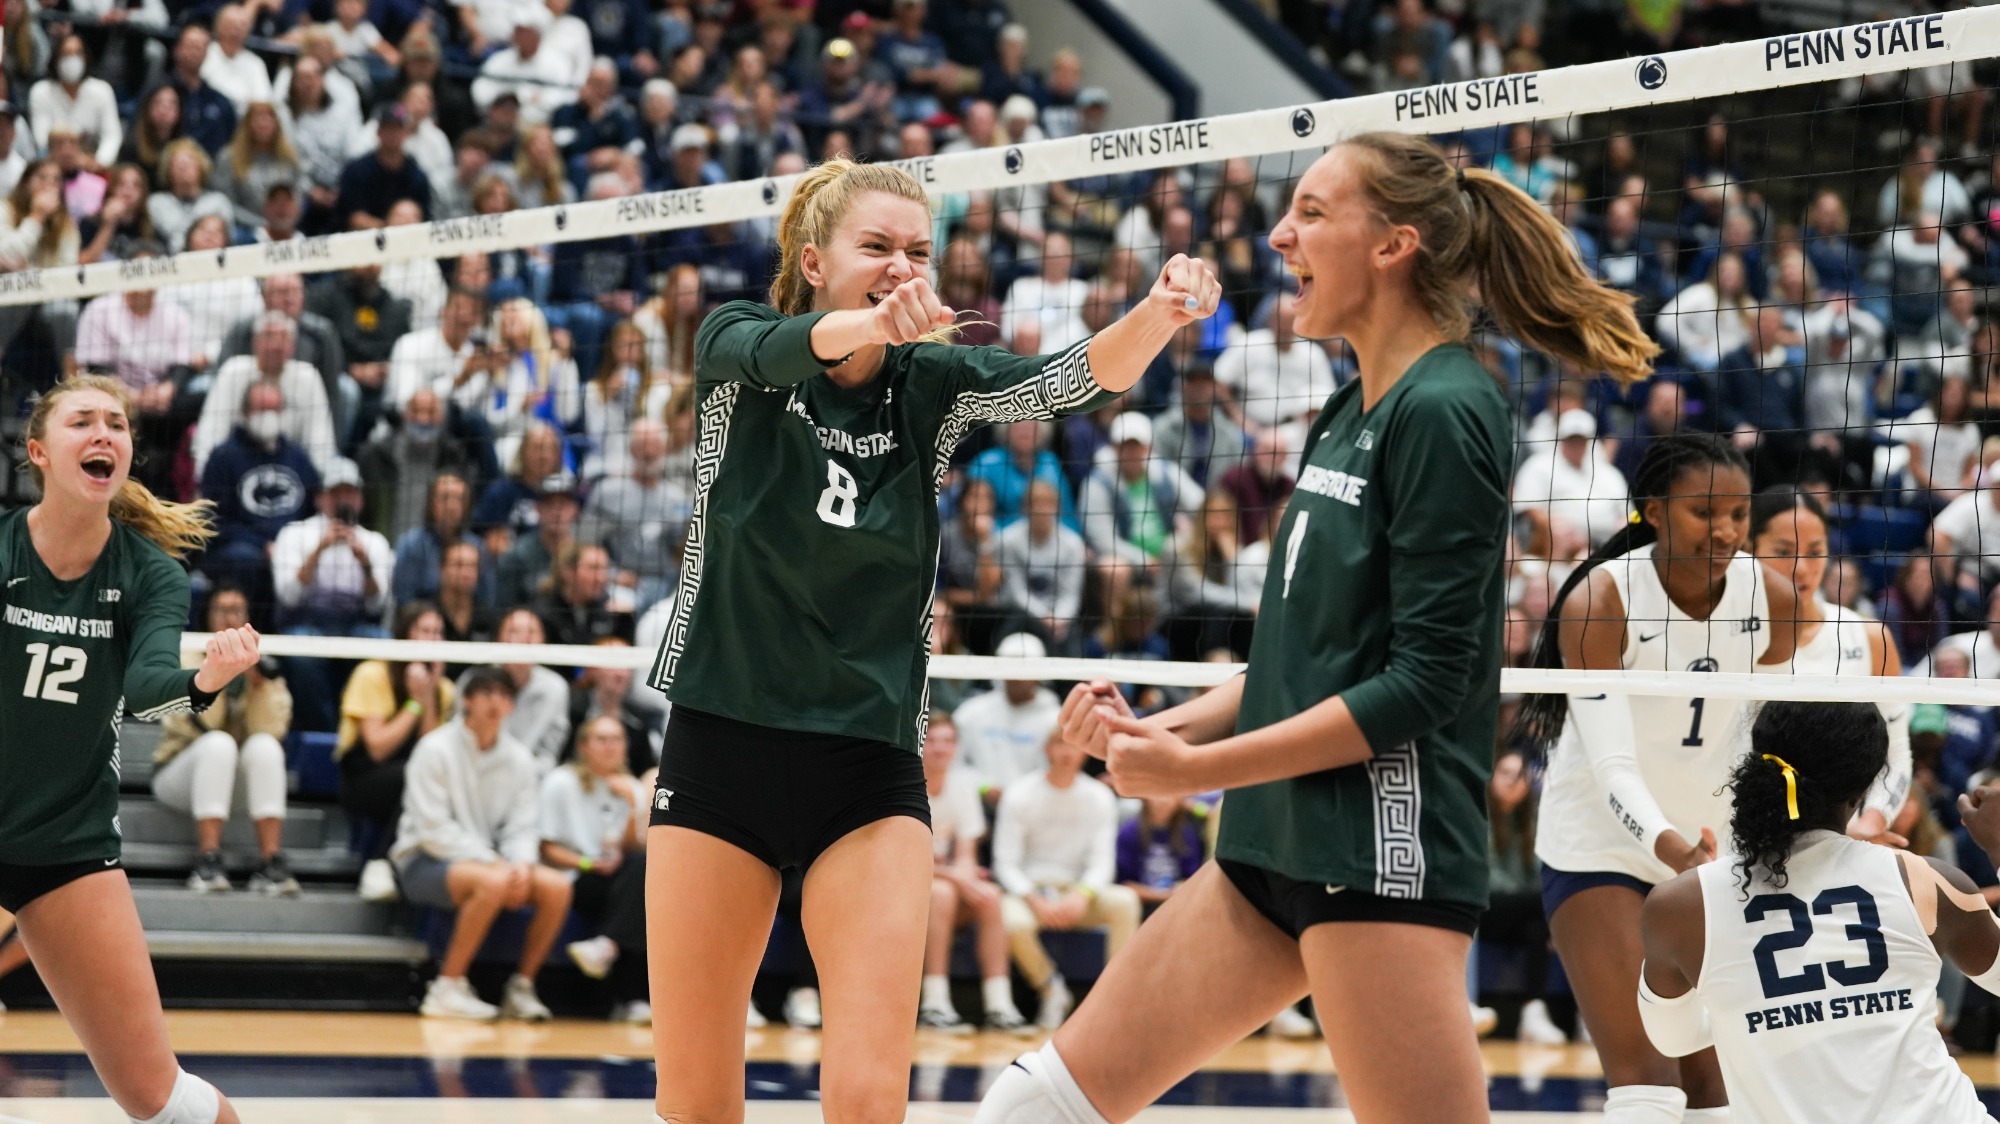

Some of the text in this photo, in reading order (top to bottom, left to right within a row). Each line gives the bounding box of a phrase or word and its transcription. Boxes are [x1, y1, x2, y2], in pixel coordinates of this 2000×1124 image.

[1766, 14, 1944, 71] PENN STATE
[1396, 74, 1539, 121] PENN STATE
[1091, 122, 1208, 162] PENN STATE
[884, 158, 935, 182] ATE
[428, 214, 504, 244] PENN STATE
[616, 189, 704, 222] PENN STATE
[816, 459, 858, 527] 8
[22, 642, 88, 704] 12
[1682, 697, 1705, 746] 1
[1609, 793, 1644, 842] WE ARE
[1743, 884, 1889, 999] 23
[1745, 988, 1913, 1034] PENN STATE
